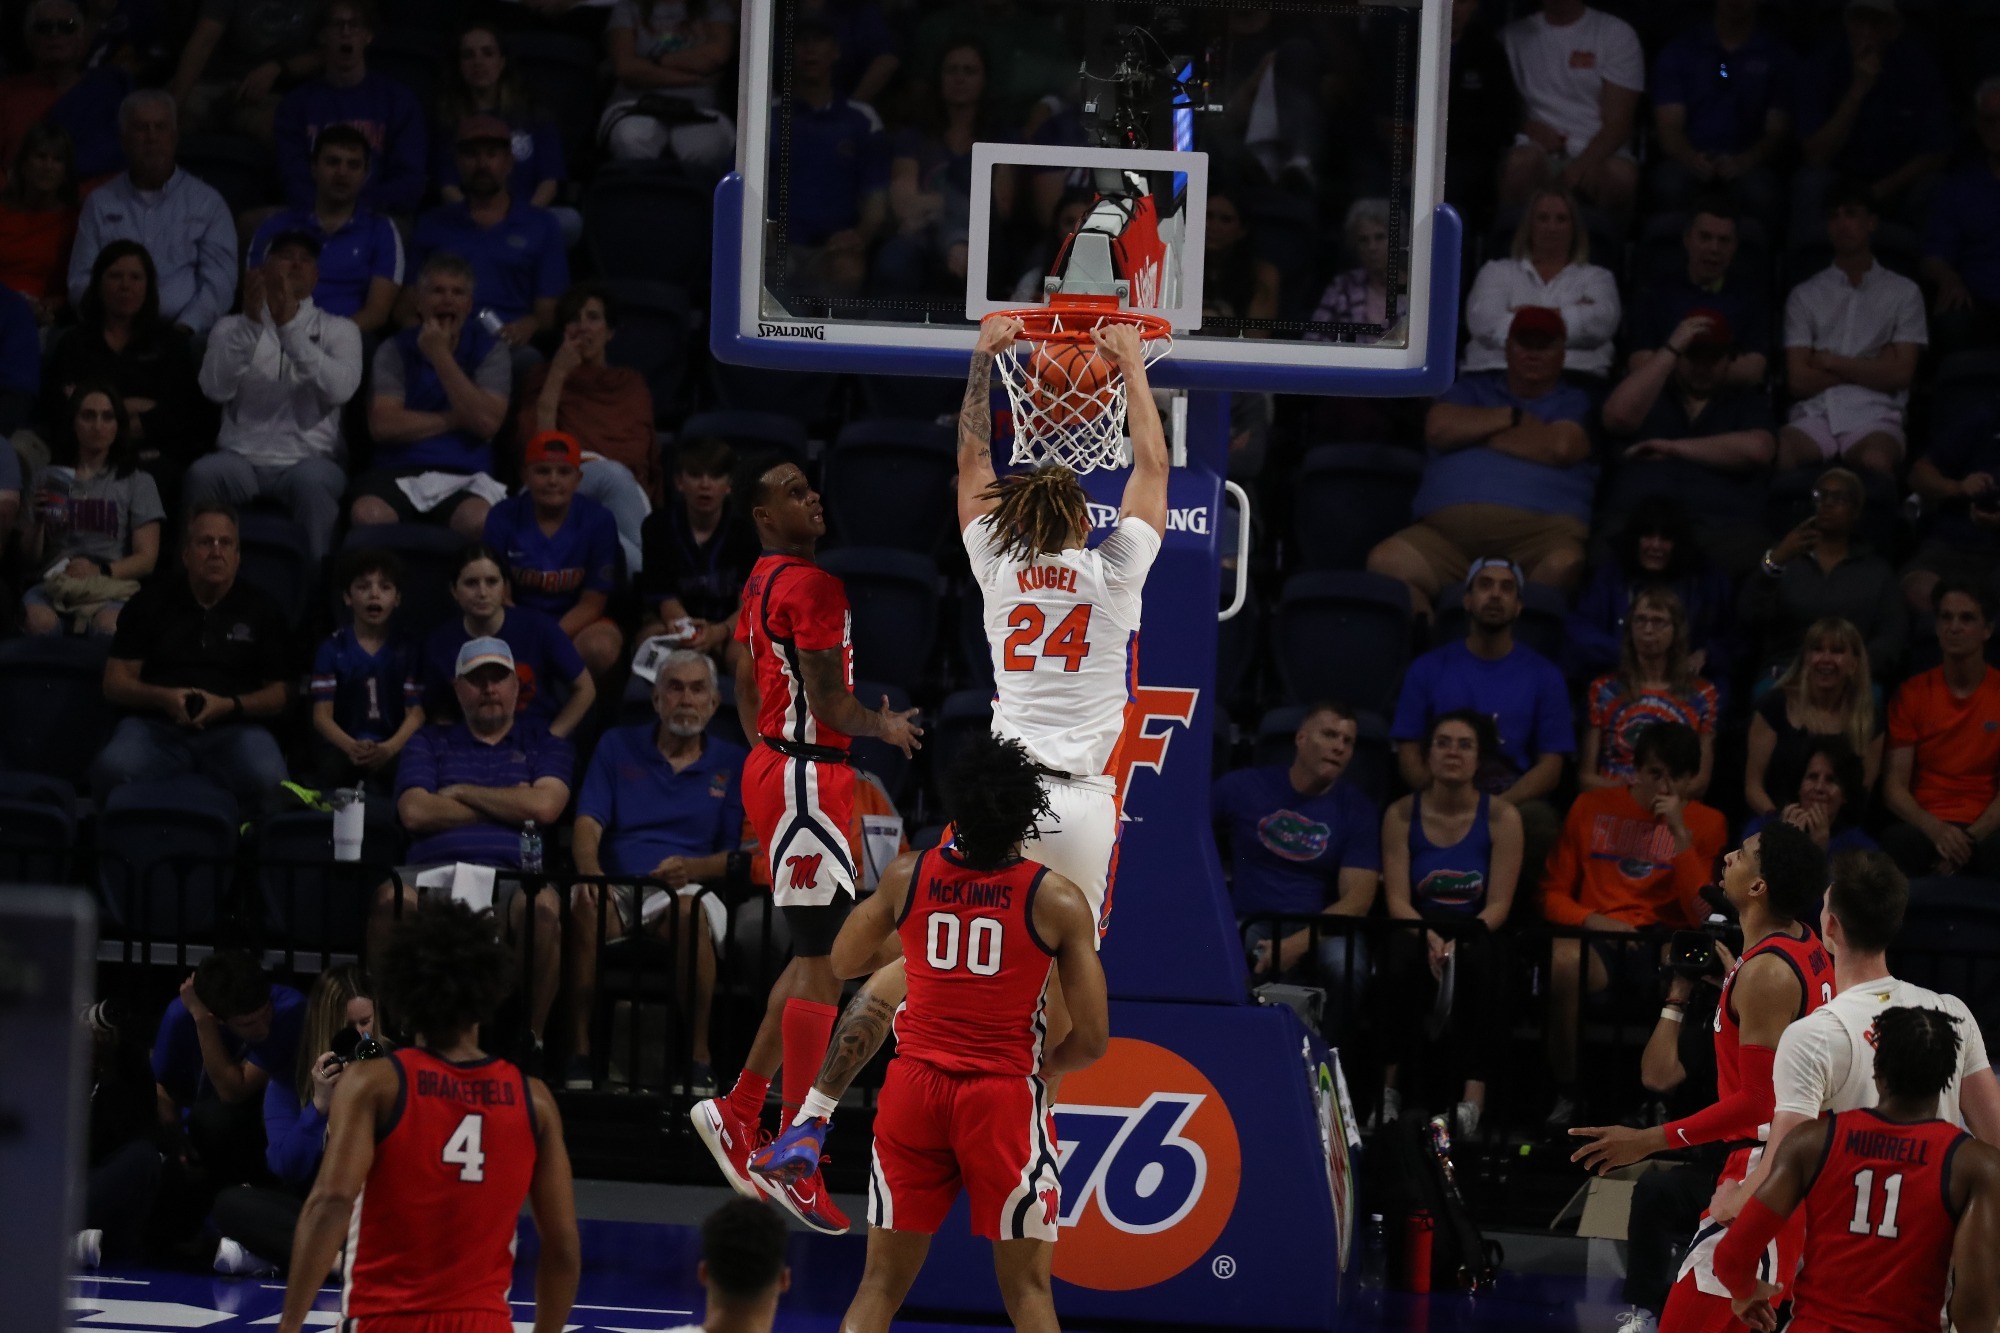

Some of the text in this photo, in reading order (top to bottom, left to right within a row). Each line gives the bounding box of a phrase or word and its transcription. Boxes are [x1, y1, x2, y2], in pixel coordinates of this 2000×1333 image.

[757, 323, 824, 340] SPALDING
[1085, 502, 1209, 535] SPNG
[1016, 566, 1078, 594] KUGEL
[1004, 603, 1092, 672] 24
[366, 677, 381, 719] 1
[1115, 685, 1200, 823] F
[926, 911, 1004, 977] 00
[417, 1069, 515, 1106] BRAKEFIELD
[441, 1112, 485, 1183] 4
[1053, 1092, 1208, 1235] 76
[1845, 1128, 1928, 1166] MURRELL
[1849, 1167, 1903, 1239] 11
